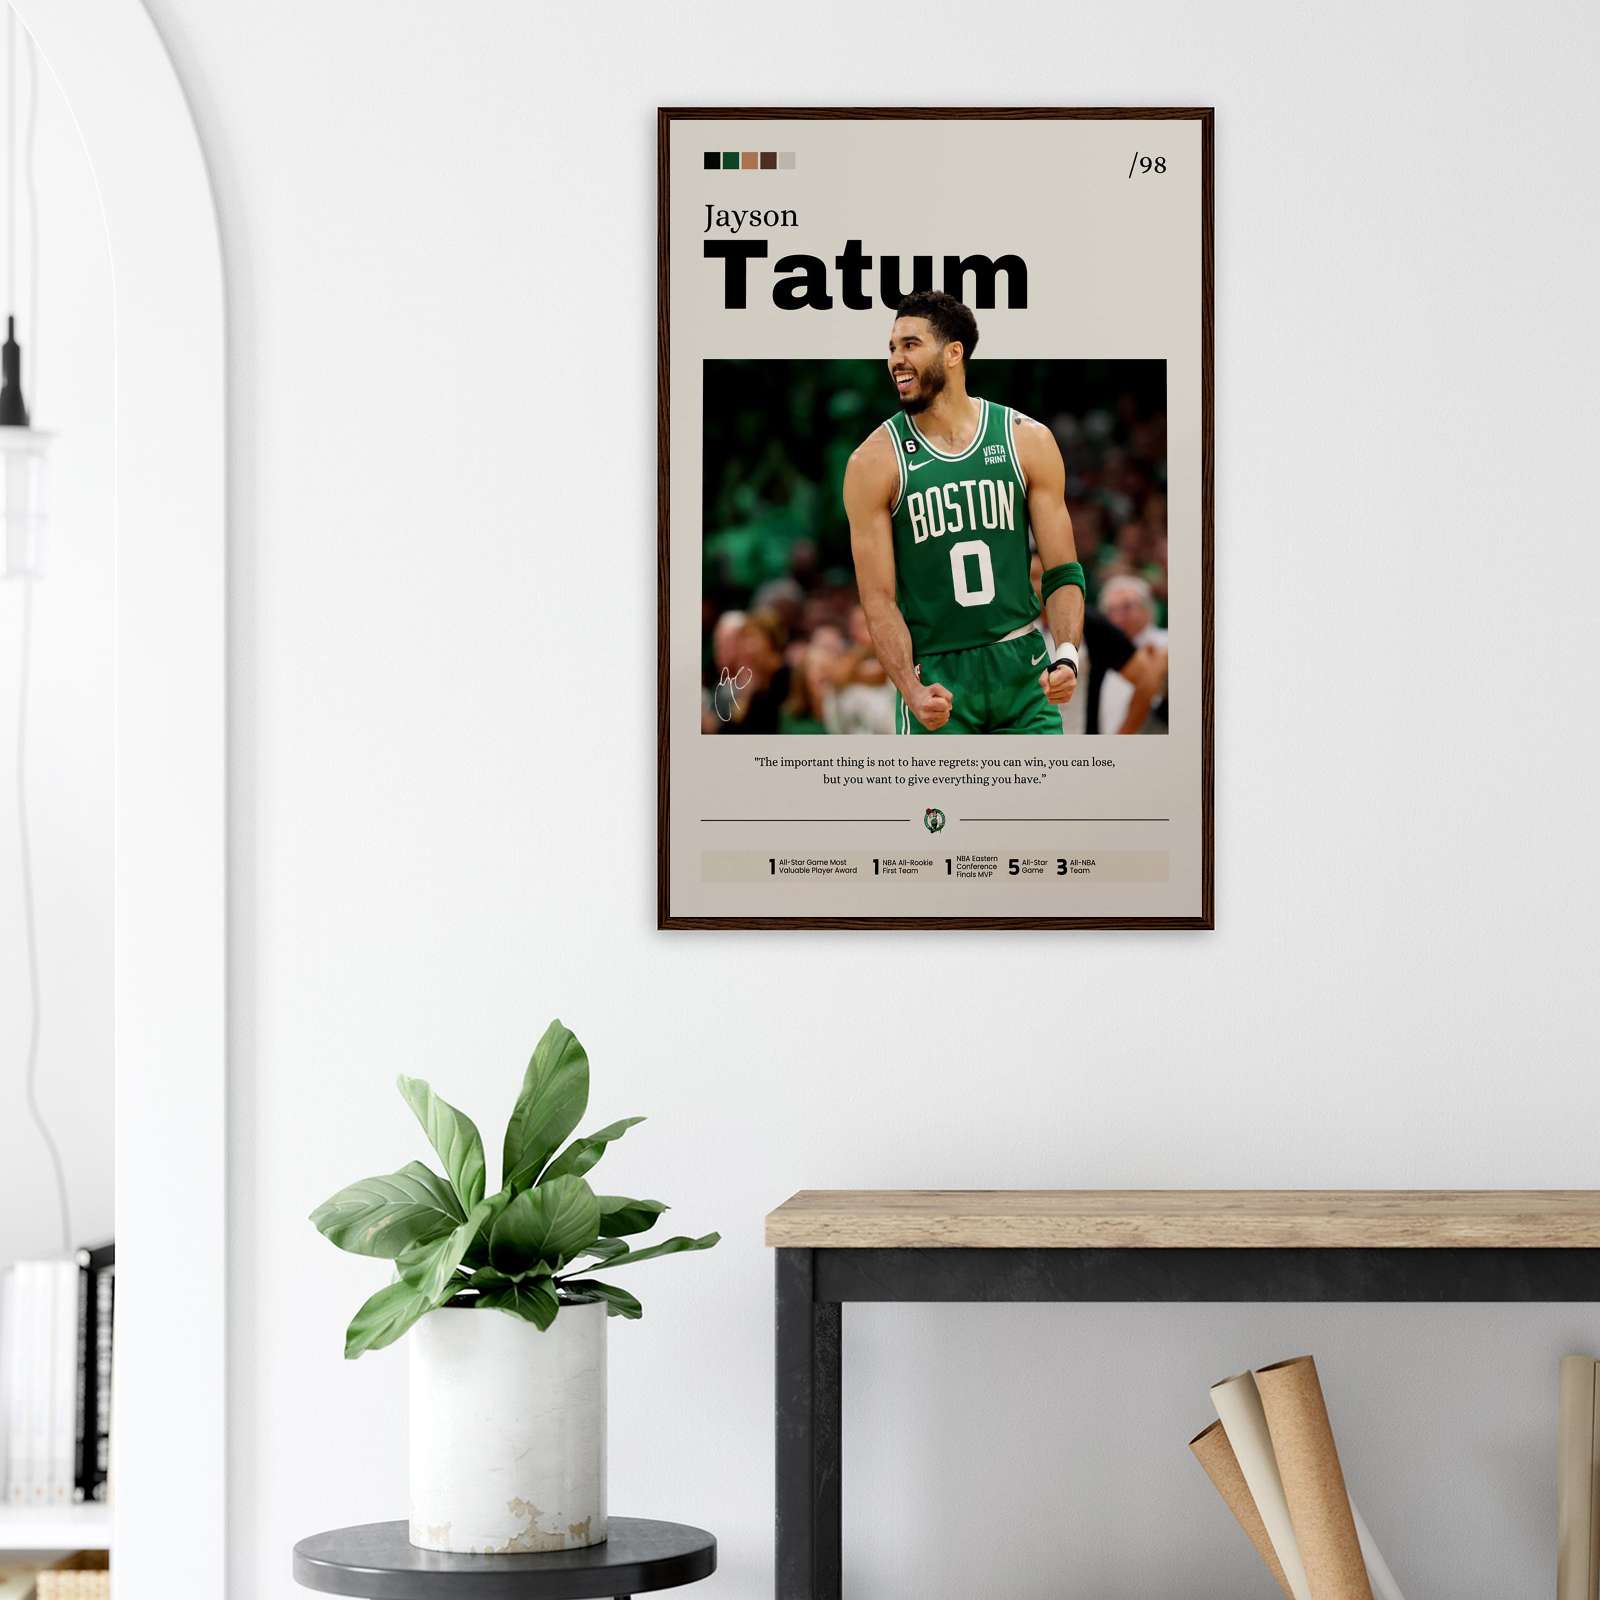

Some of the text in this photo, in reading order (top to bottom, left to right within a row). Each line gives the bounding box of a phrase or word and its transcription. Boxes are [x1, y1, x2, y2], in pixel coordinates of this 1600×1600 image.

[1128, 151, 1167, 180] /98
[703, 203, 800, 234] Jayson
[703, 239, 1028, 311] Tatum
[905, 440, 917, 453] 6
[983, 444, 1005, 456] VISTA
[984, 454, 1007, 465] PRINT
[907, 479, 1015, 544] BOSTON
[949, 540, 995, 607] 0
[781, 756, 835, 769] important
[837, 756, 865, 770] thing
[867, 756, 876, 767] is
[878, 757, 895, 767] not
[898, 757, 910, 767] to
[911, 756, 937, 767] have
[939, 758, 979, 770] regrets:
[981, 759, 1001, 769] you
[1003, 759, 1022, 767] can
[1024, 756, 1047, 768] win,
[1049, 759, 1069, 769] you
[1071, 759, 1090, 767] can
[1092, 756, 1116, 769] lose,
[823, 773, 841, 784] but
[843, 776, 864, 786] you
[866, 775, 892, 784] want
[895, 775, 906, 784] to
[908, 774, 930, 787] give
[932, 773, 990, 787] everything
[991, 776, 1012, 787] you
[778, 858, 805, 866] All-Star
[956, 855, 999, 863] NBA Eastern
[1021, 858, 1049, 866] All-Star
[1070, 858, 1097, 866] All-NBA
[769, 858, 776, 875] 1
[778, 866, 858, 876] Valuable Player Award
[872, 858, 880, 876] 1
[945, 858, 952, 876] 1
[956, 863, 998, 871] Conference
[1008, 858, 1020, 876] 5
[1021, 866, 1044, 874] Game
[1056, 858, 1068, 876] 3
[956, 870, 976, 879] Finals
